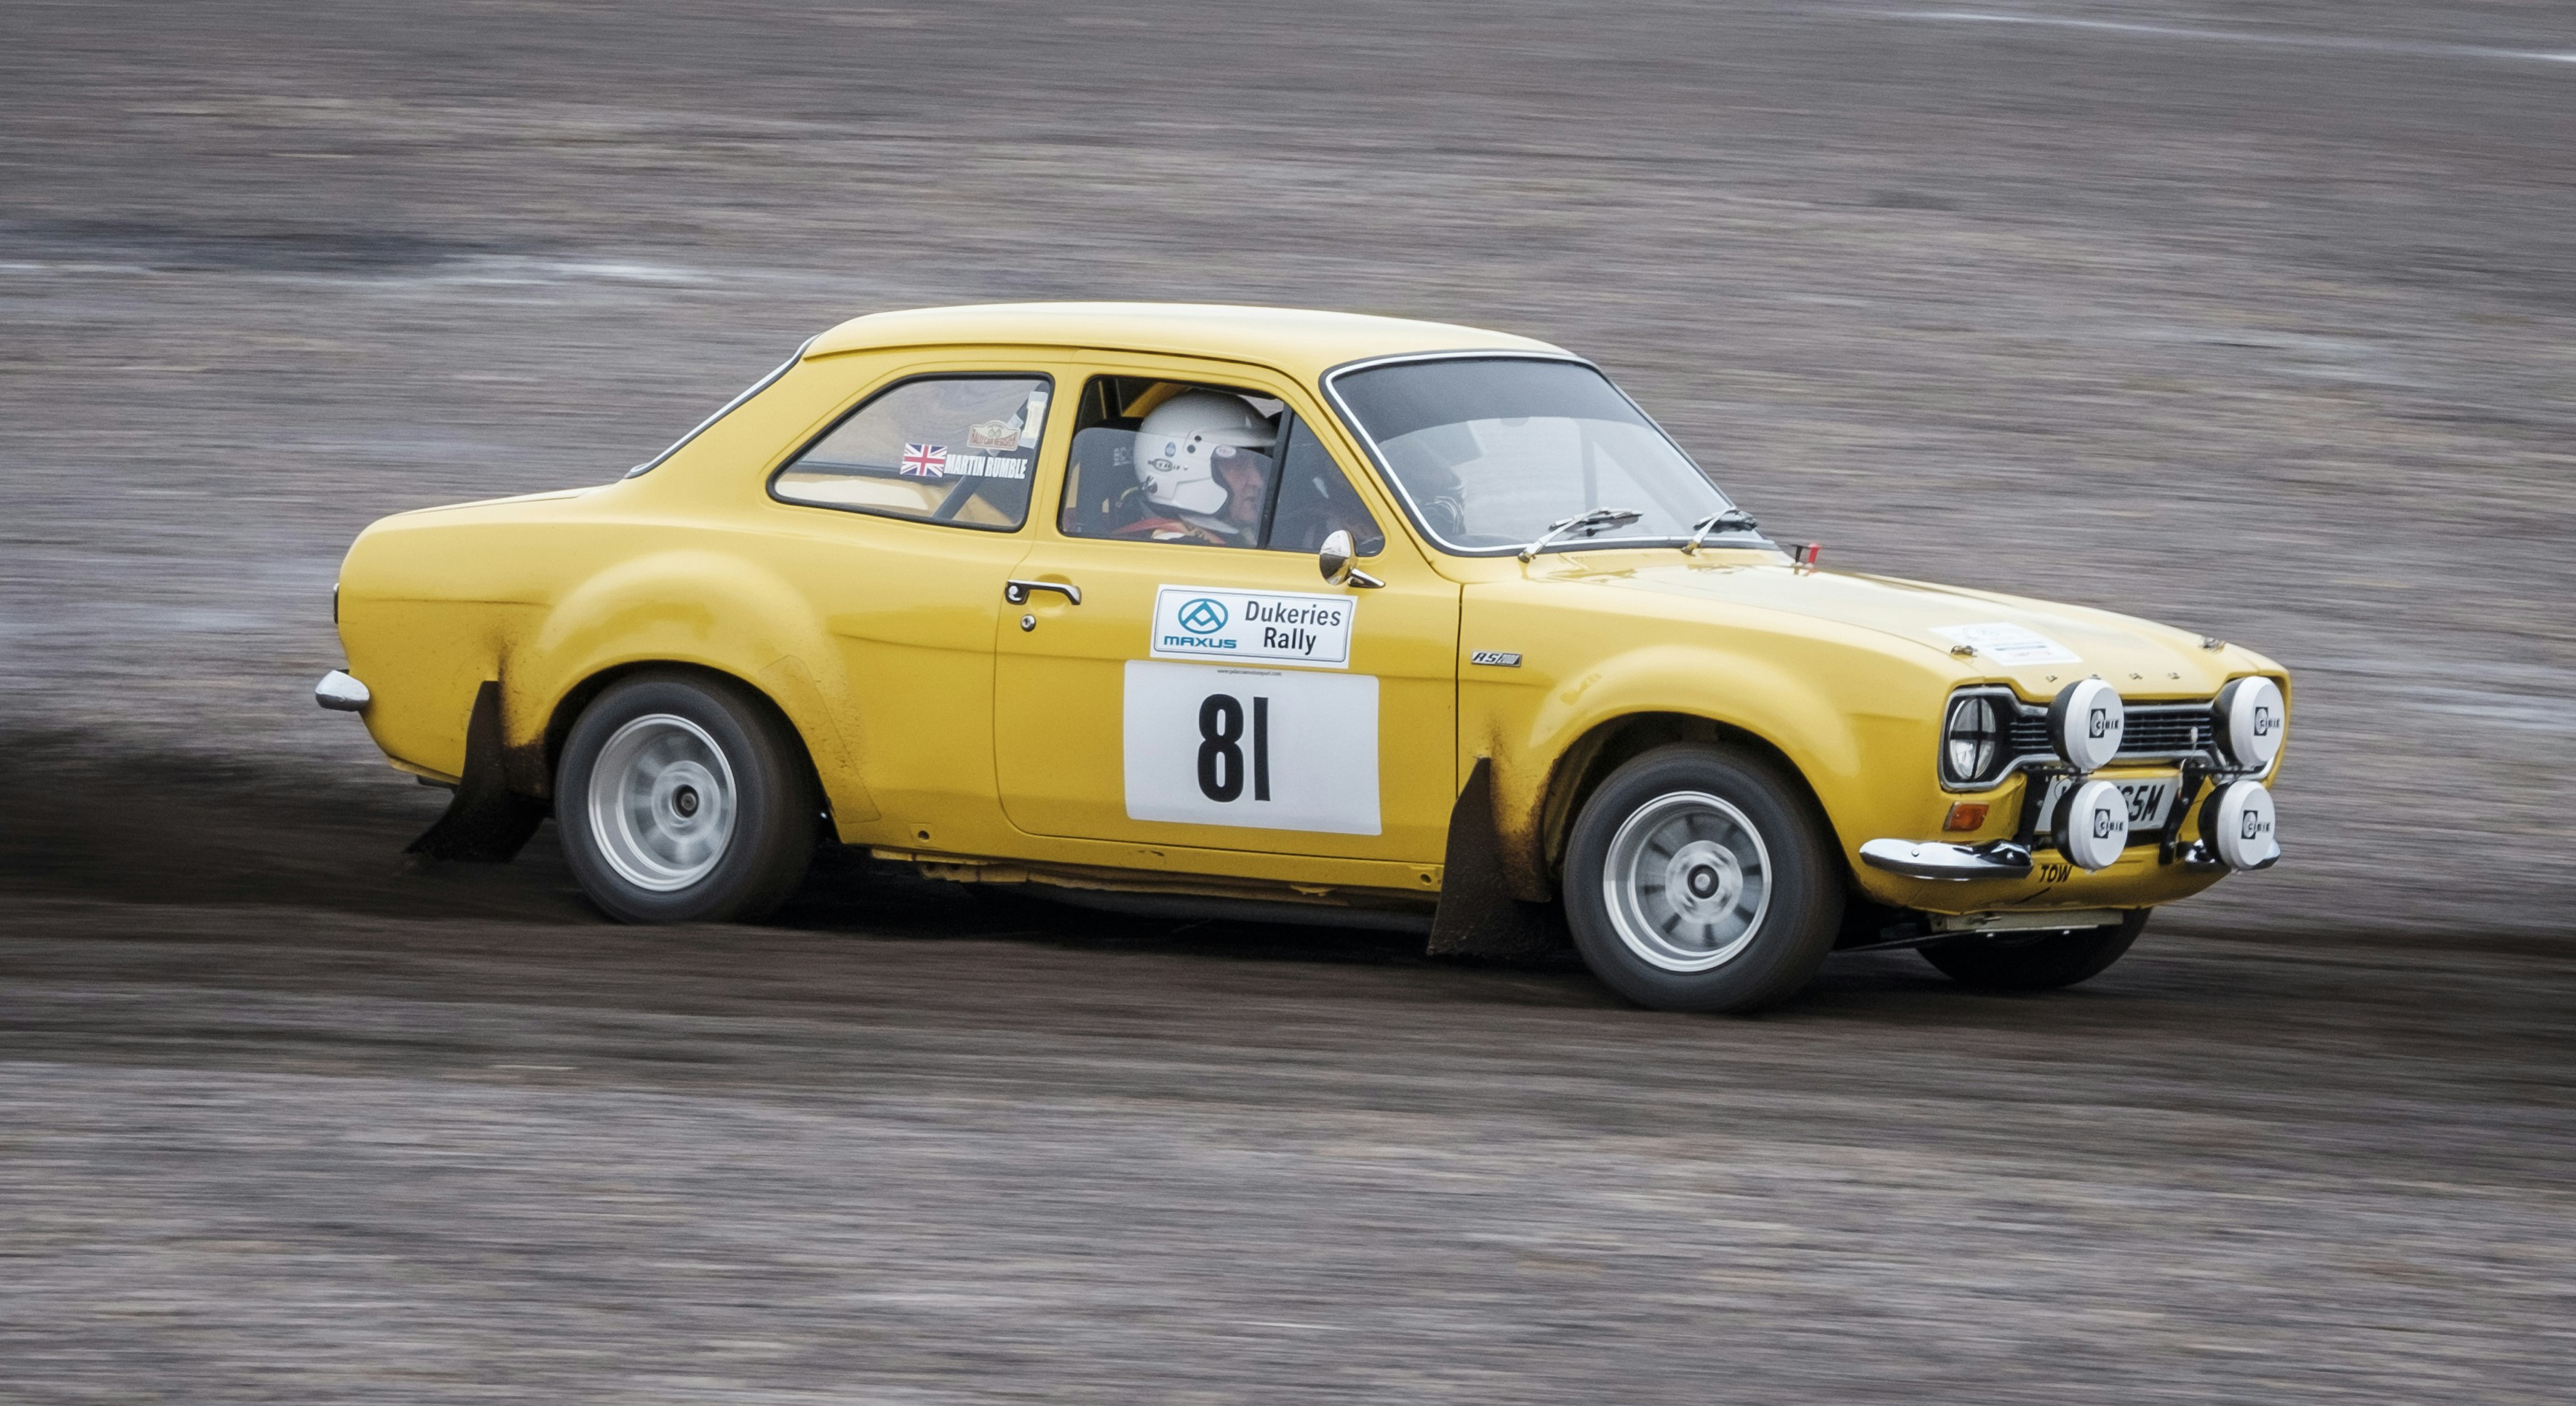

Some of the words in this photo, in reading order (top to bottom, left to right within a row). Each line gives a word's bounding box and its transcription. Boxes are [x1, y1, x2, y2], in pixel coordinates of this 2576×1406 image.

[944, 454, 986, 476] MARTIN
[1245, 601, 1341, 627] Dukeries
[1163, 635, 1237, 650] MAXUS
[1264, 627, 1317, 655] Rally
[2096, 720, 2119, 730] CIBIE
[1197, 693, 1271, 803] 81
[2100, 821, 2124, 831] CIBIE
[2039, 864, 2073, 883] TOW
